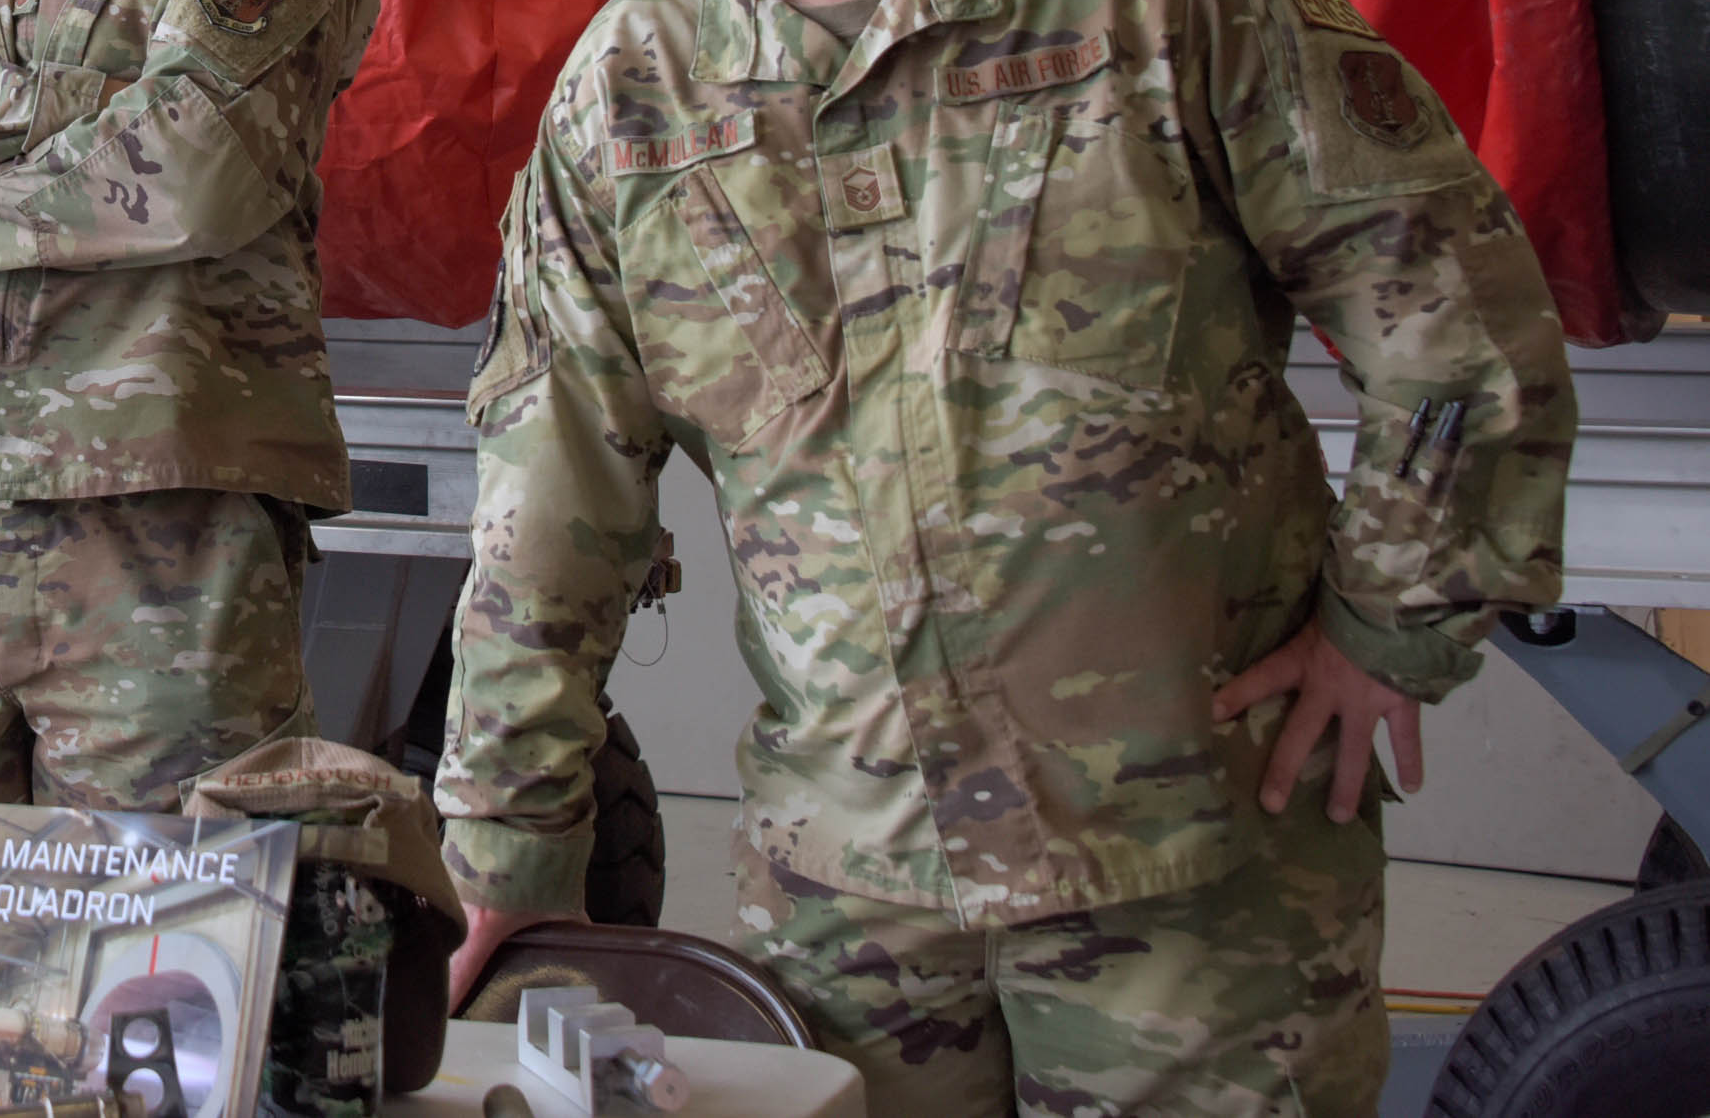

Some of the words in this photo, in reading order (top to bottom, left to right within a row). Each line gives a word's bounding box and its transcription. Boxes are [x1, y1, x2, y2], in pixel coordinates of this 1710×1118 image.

[946, 72, 986, 97] U.S.
[993, 56, 1033, 90] AIR
[1035, 36, 1103, 82] FORCE
[614, 120, 739, 171] McMULLAN
[1, 838, 240, 885] MAINTENANCE
